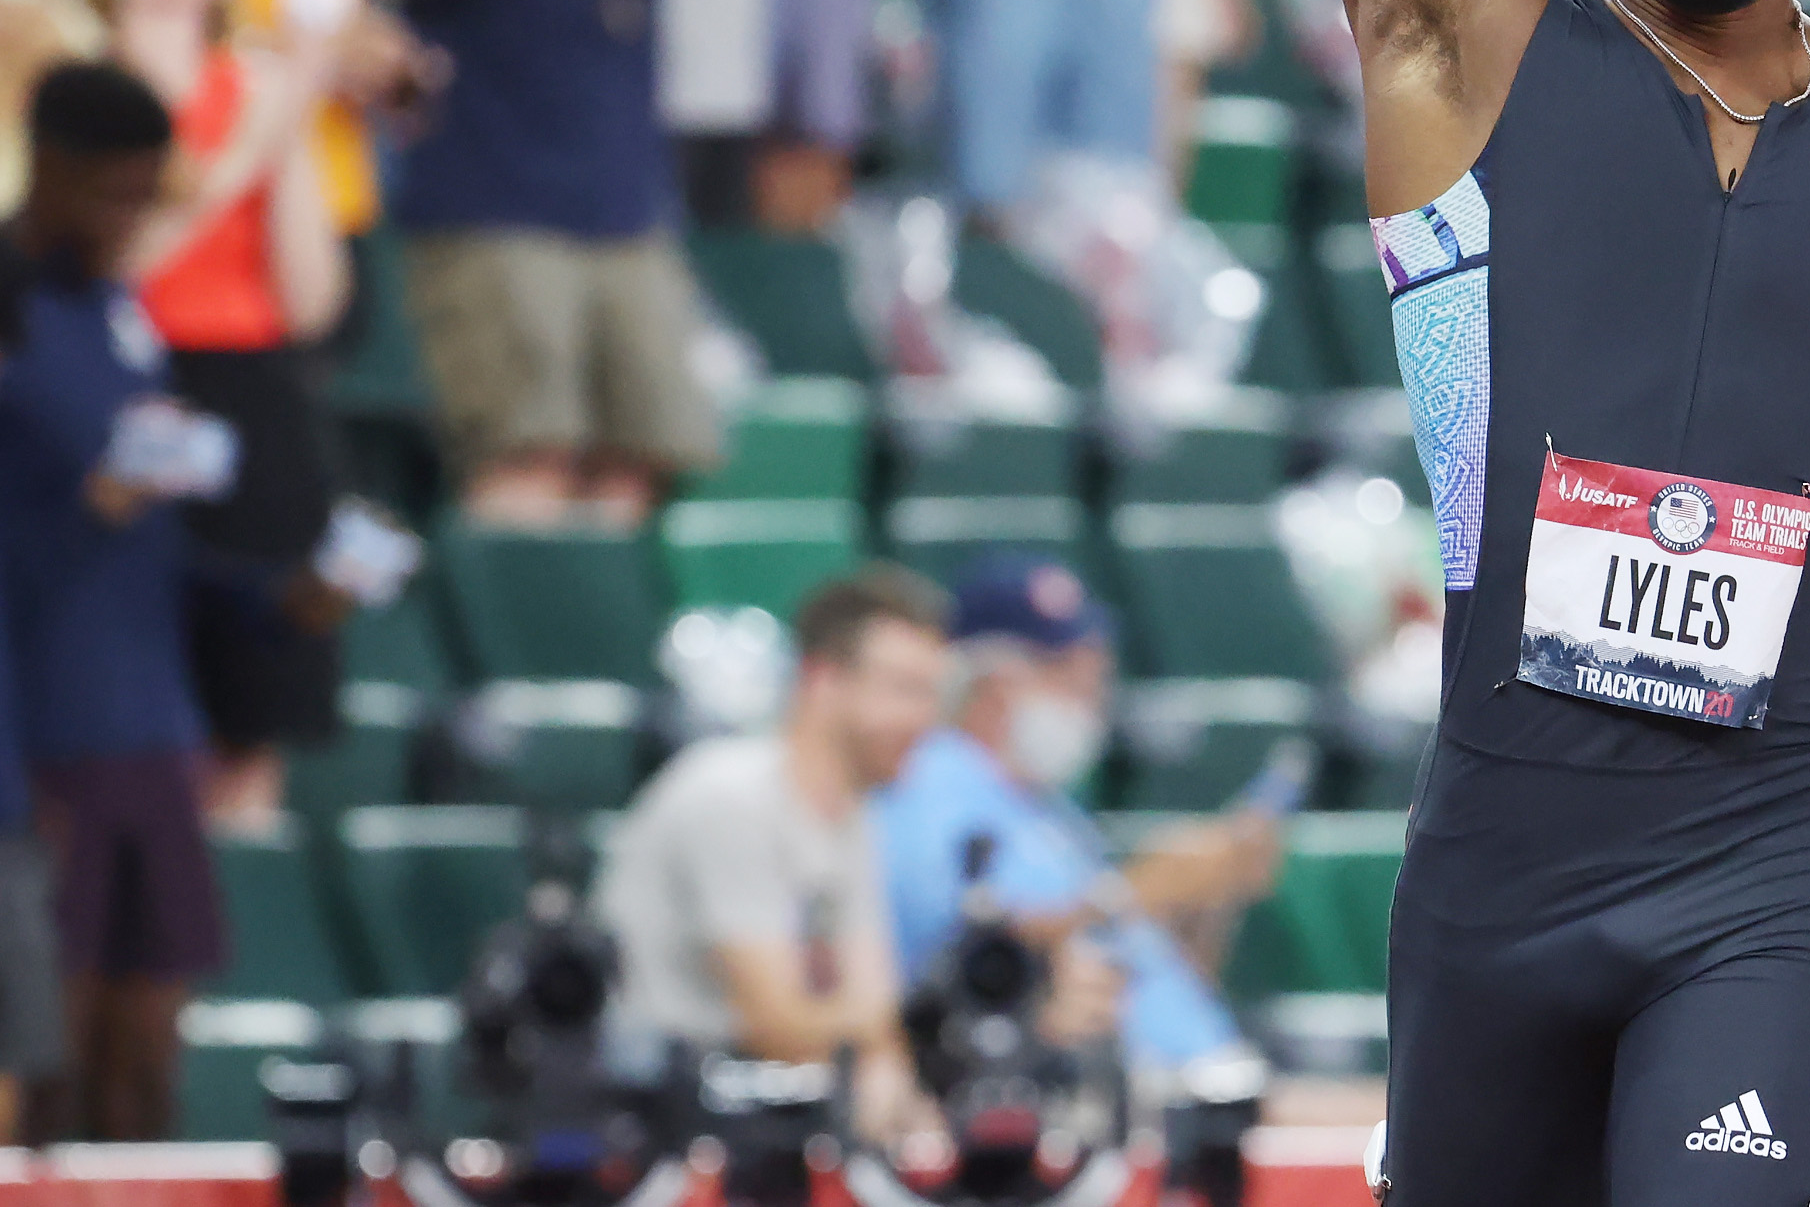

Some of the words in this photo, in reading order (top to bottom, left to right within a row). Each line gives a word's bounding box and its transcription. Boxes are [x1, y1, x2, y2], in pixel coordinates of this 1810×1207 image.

[1580, 487, 1639, 509] USATF
[1657, 483, 1686, 499] UNITED
[1688, 484, 1713, 507] STATES
[1733, 498, 1758, 521] U.S.
[1652, 528, 1682, 551] OLYMPIC
[1684, 537, 1705, 551] TEAM
[1730, 518, 1767, 543] TEAM
[1769, 525, 1809, 551] TRIALS
[1729, 538, 1756, 550] TRACK
[1763, 545, 1785, 555] FIELD
[1599, 554, 1738, 651] LYLES
[1685, 1127, 1788, 1160] adidas
